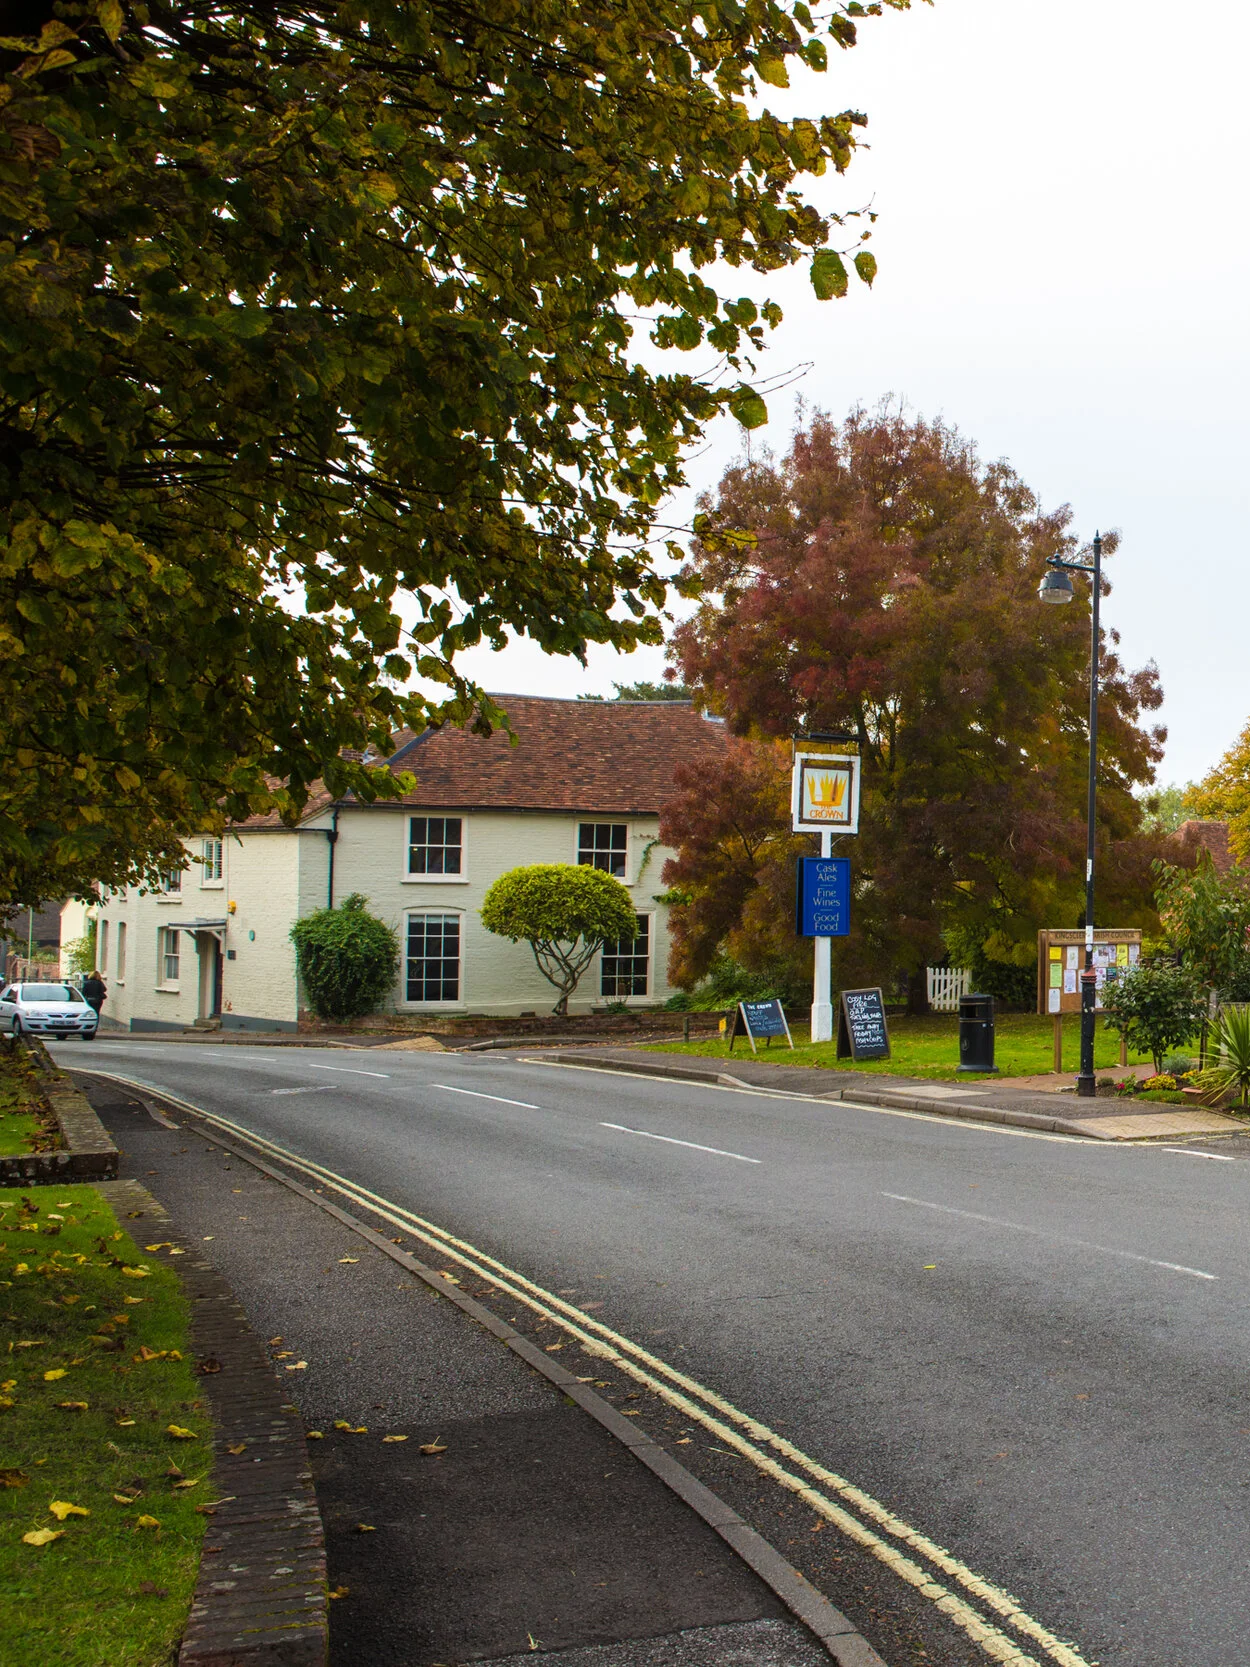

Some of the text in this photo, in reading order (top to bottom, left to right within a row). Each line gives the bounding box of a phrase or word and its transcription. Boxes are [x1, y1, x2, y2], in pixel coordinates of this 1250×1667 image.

[809, 809, 844, 819] CROWN
[816, 863, 838, 873] Cask
[817, 873, 837, 882] Ales
[817, 887, 837, 897] Fine
[812, 897, 841, 907] Wines
[813, 912, 840, 922] Good
[814, 921, 839, 931] Food
